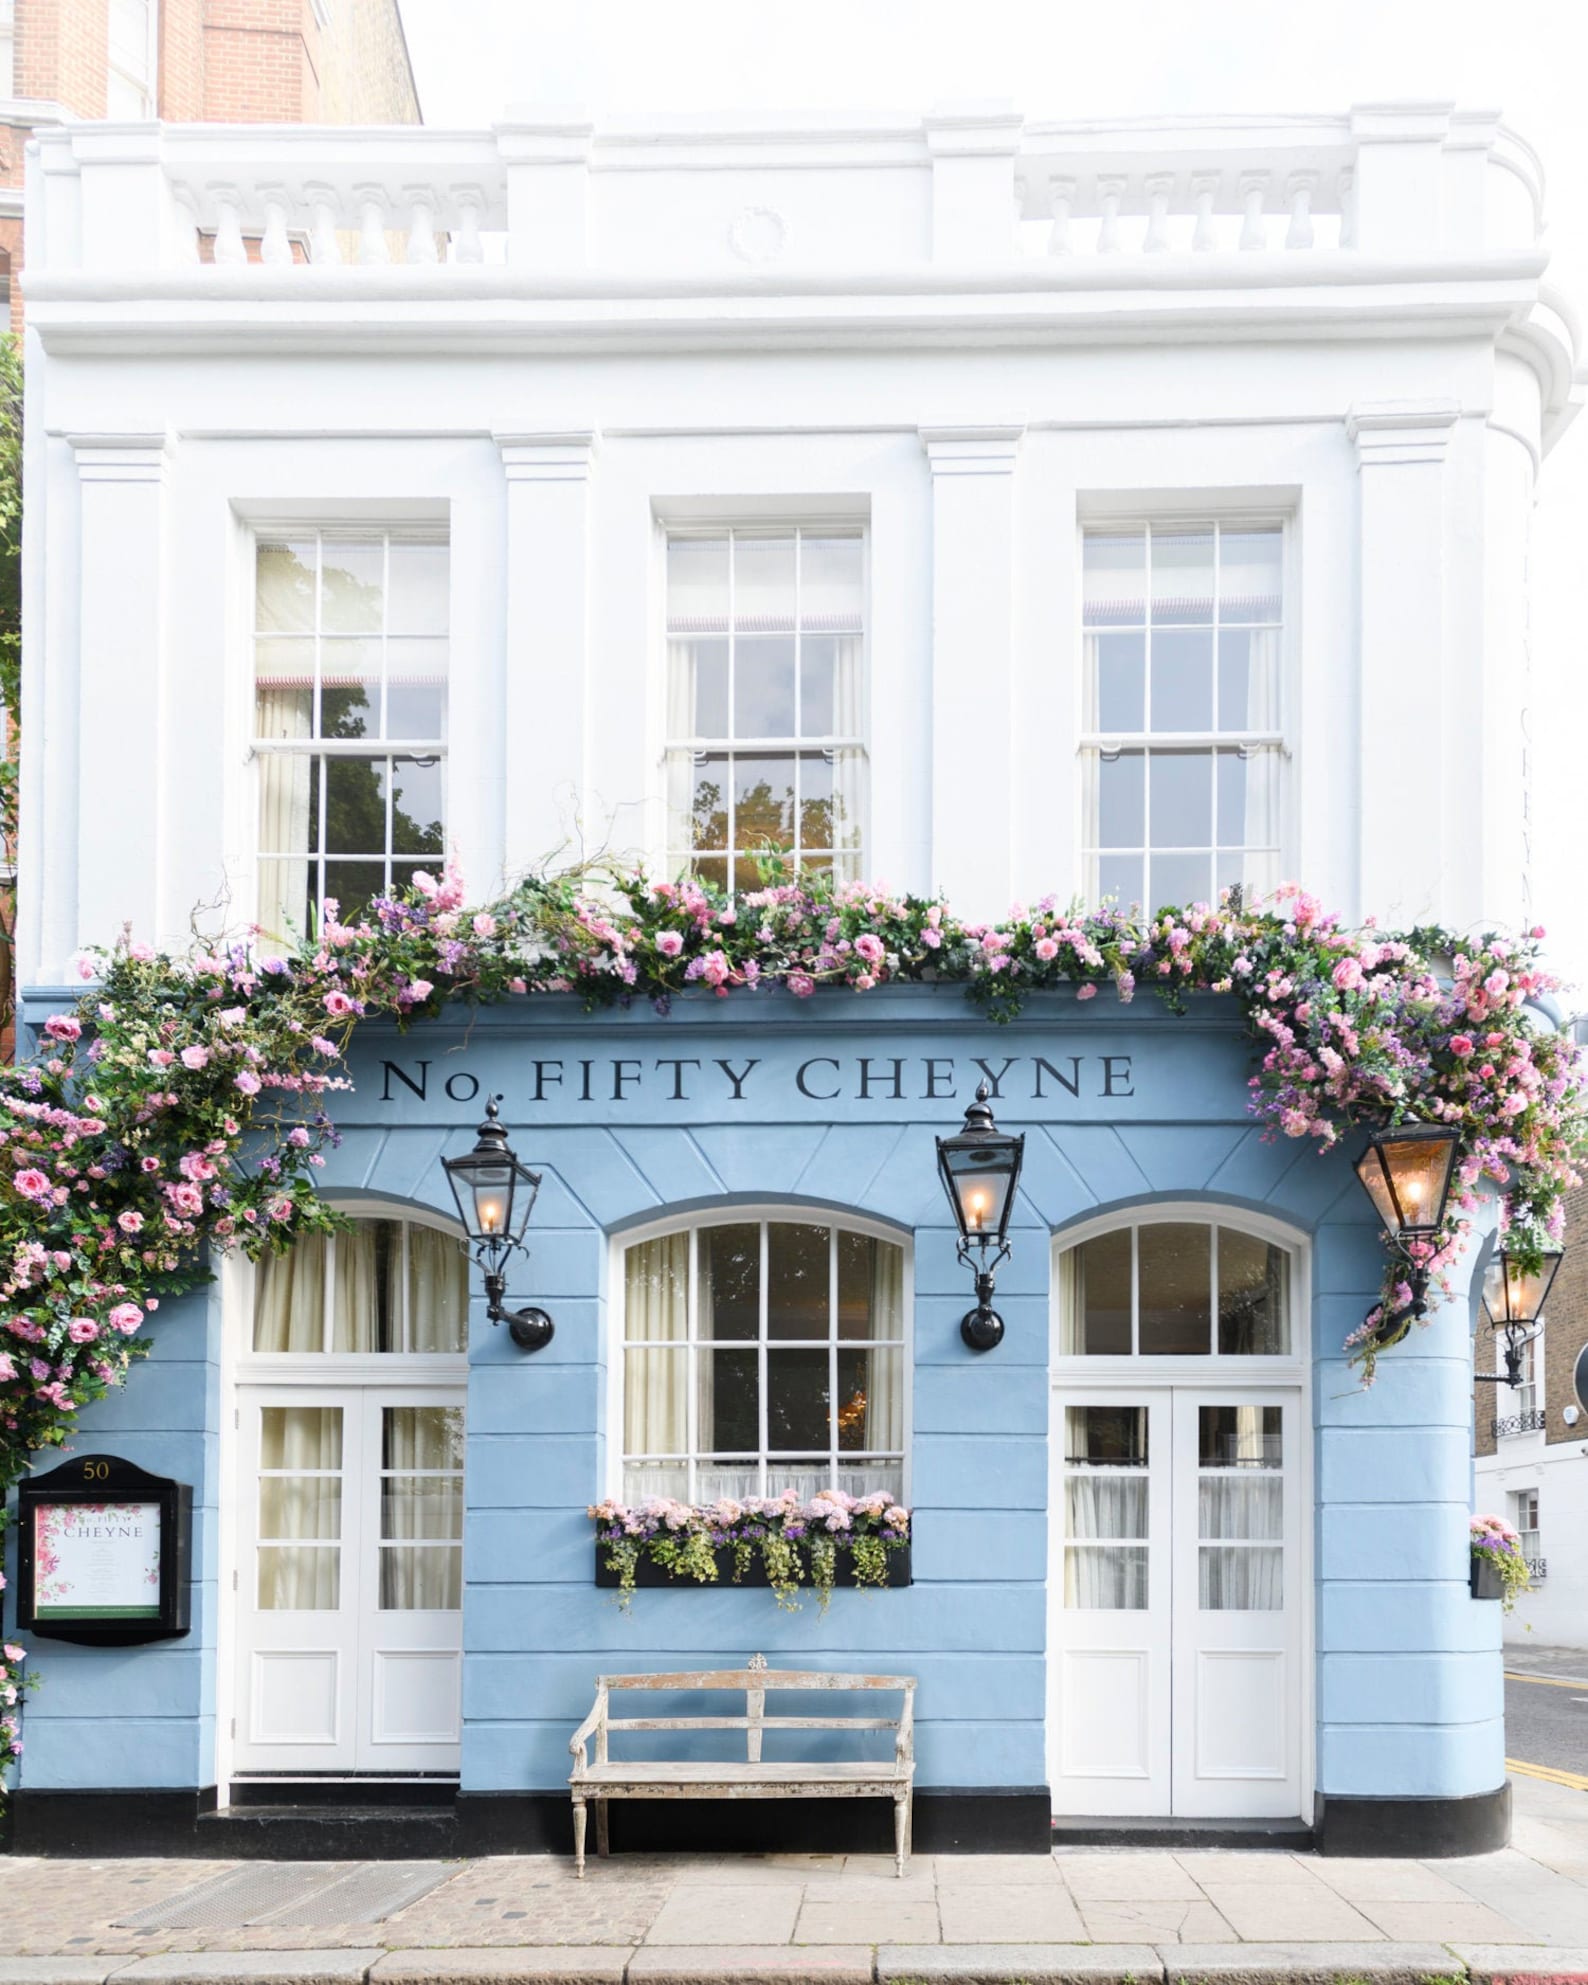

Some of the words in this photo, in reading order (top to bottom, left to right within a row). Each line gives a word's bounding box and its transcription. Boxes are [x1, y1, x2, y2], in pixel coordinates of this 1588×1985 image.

[379, 1060, 504, 1101] No.
[529, 1059, 762, 1101] FIFTY
[795, 1056, 1135, 1100] CHEYNE
[84, 1461, 109, 1480] 50
[64, 1527, 143, 1538] CHEYNE
